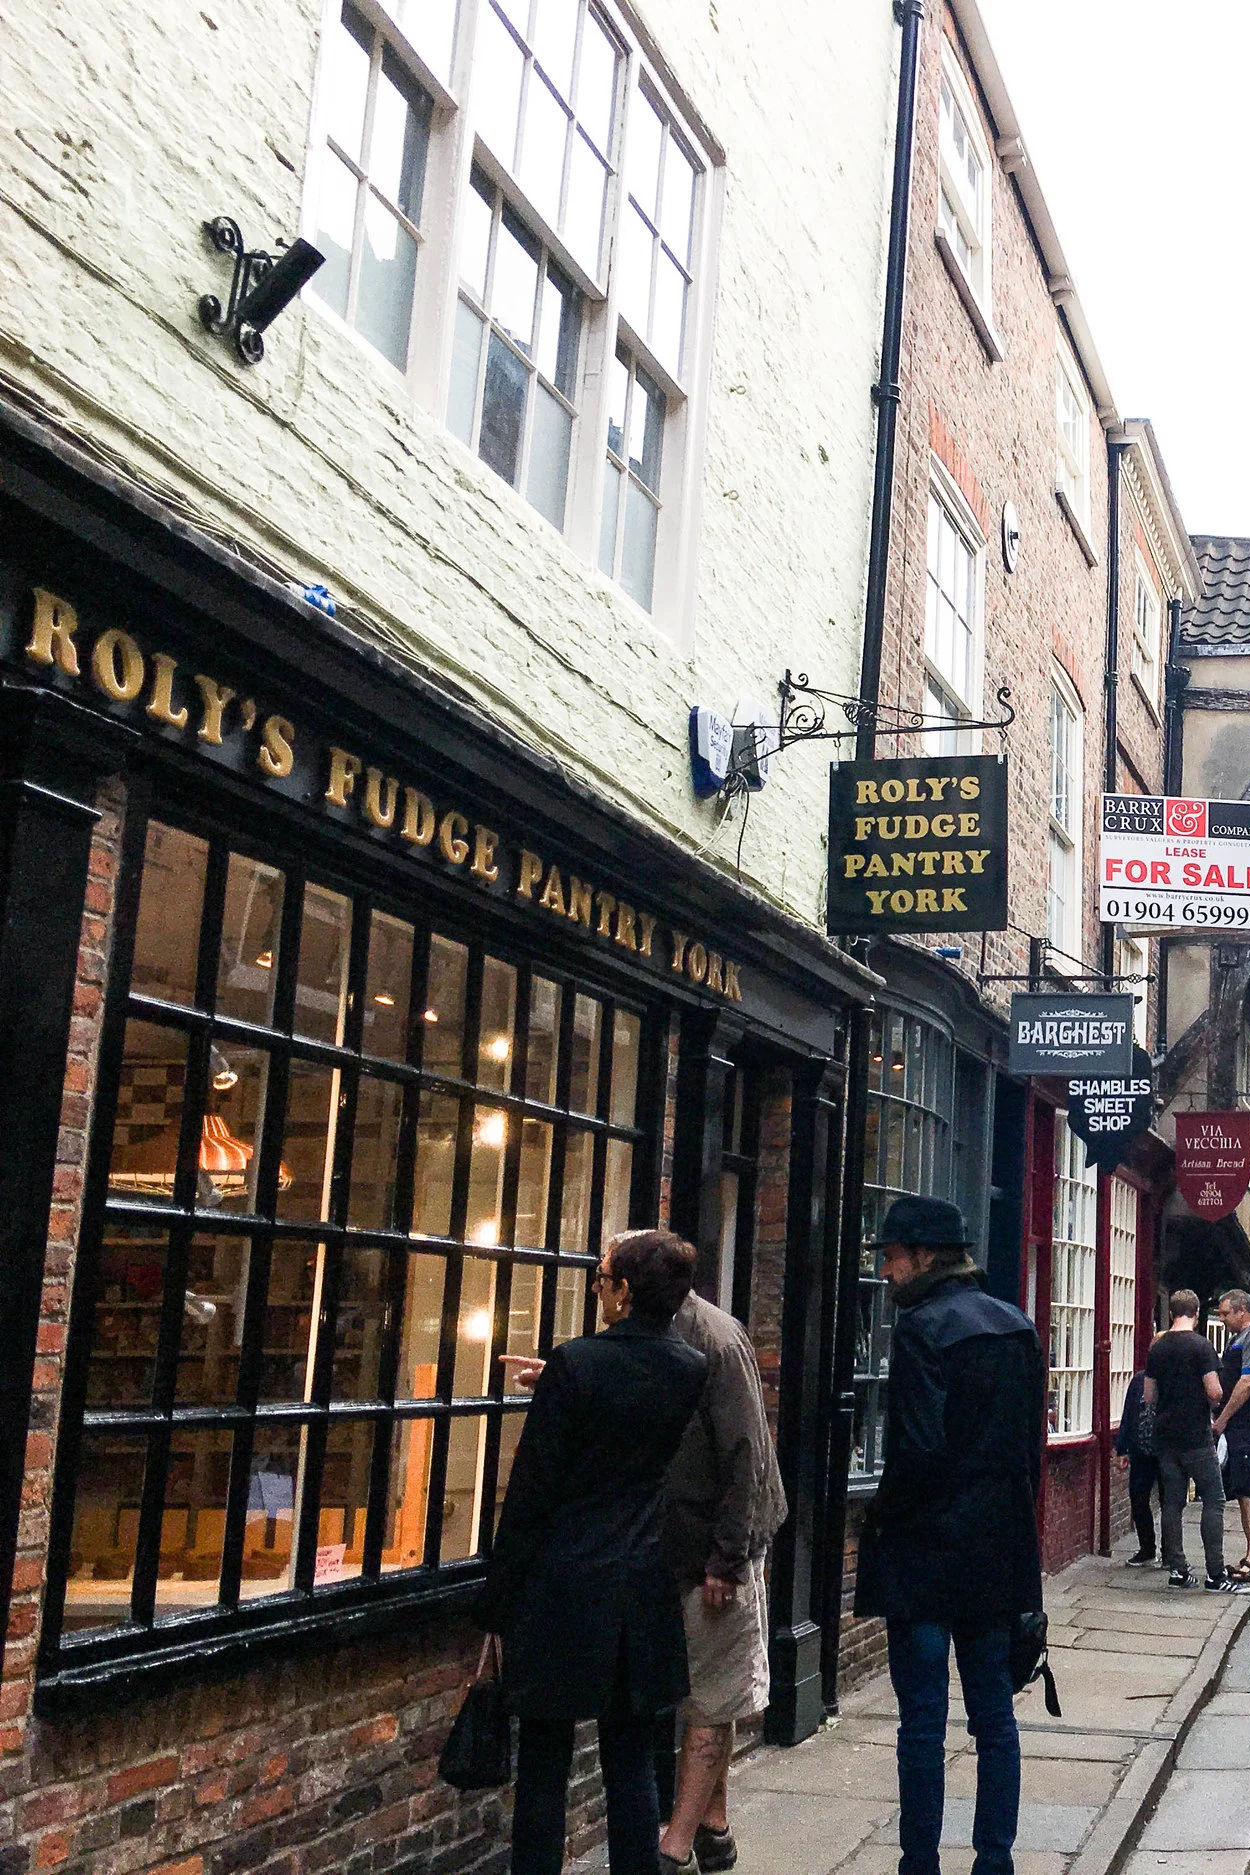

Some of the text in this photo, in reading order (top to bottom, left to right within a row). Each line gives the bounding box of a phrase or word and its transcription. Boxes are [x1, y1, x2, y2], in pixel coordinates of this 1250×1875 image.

[26, 587, 743, 1002] ROLY'S FUDGE PANTRY YORK
[855, 776, 981, 804] ROLY'S
[1104, 799, 1163, 816] BARRY
[854, 812, 981, 841] FUDGE
[1104, 815, 1163, 832] CRUX
[1168, 802, 1205, 835] &
[1165, 847, 1207, 858] LEASE
[843, 850, 991, 878] PANTRY
[1105, 858, 1172, 885] FOR
[865, 888, 968, 914] YORK
[1146, 892, 1225, 902] www.barrycrux.co.uk
[1107, 900, 1175, 922] 01904
[1017, 1021, 1126, 1047] BARGHEST
[1068, 1079, 1151, 1096] SHAMBLES
[1084, 1098, 1136, 1114] SWEET
[1089, 1115, 1131, 1132] SHOP
[1200, 1125, 1223, 1137] VIA
[1184, 1138, 1242, 1150] VECCHIA
[1181, 1157, 1245, 1169] Artisan Bread
[1200, 1190, 1221, 1198] 01904
[1204, 1182, 1216, 1190] Tel
